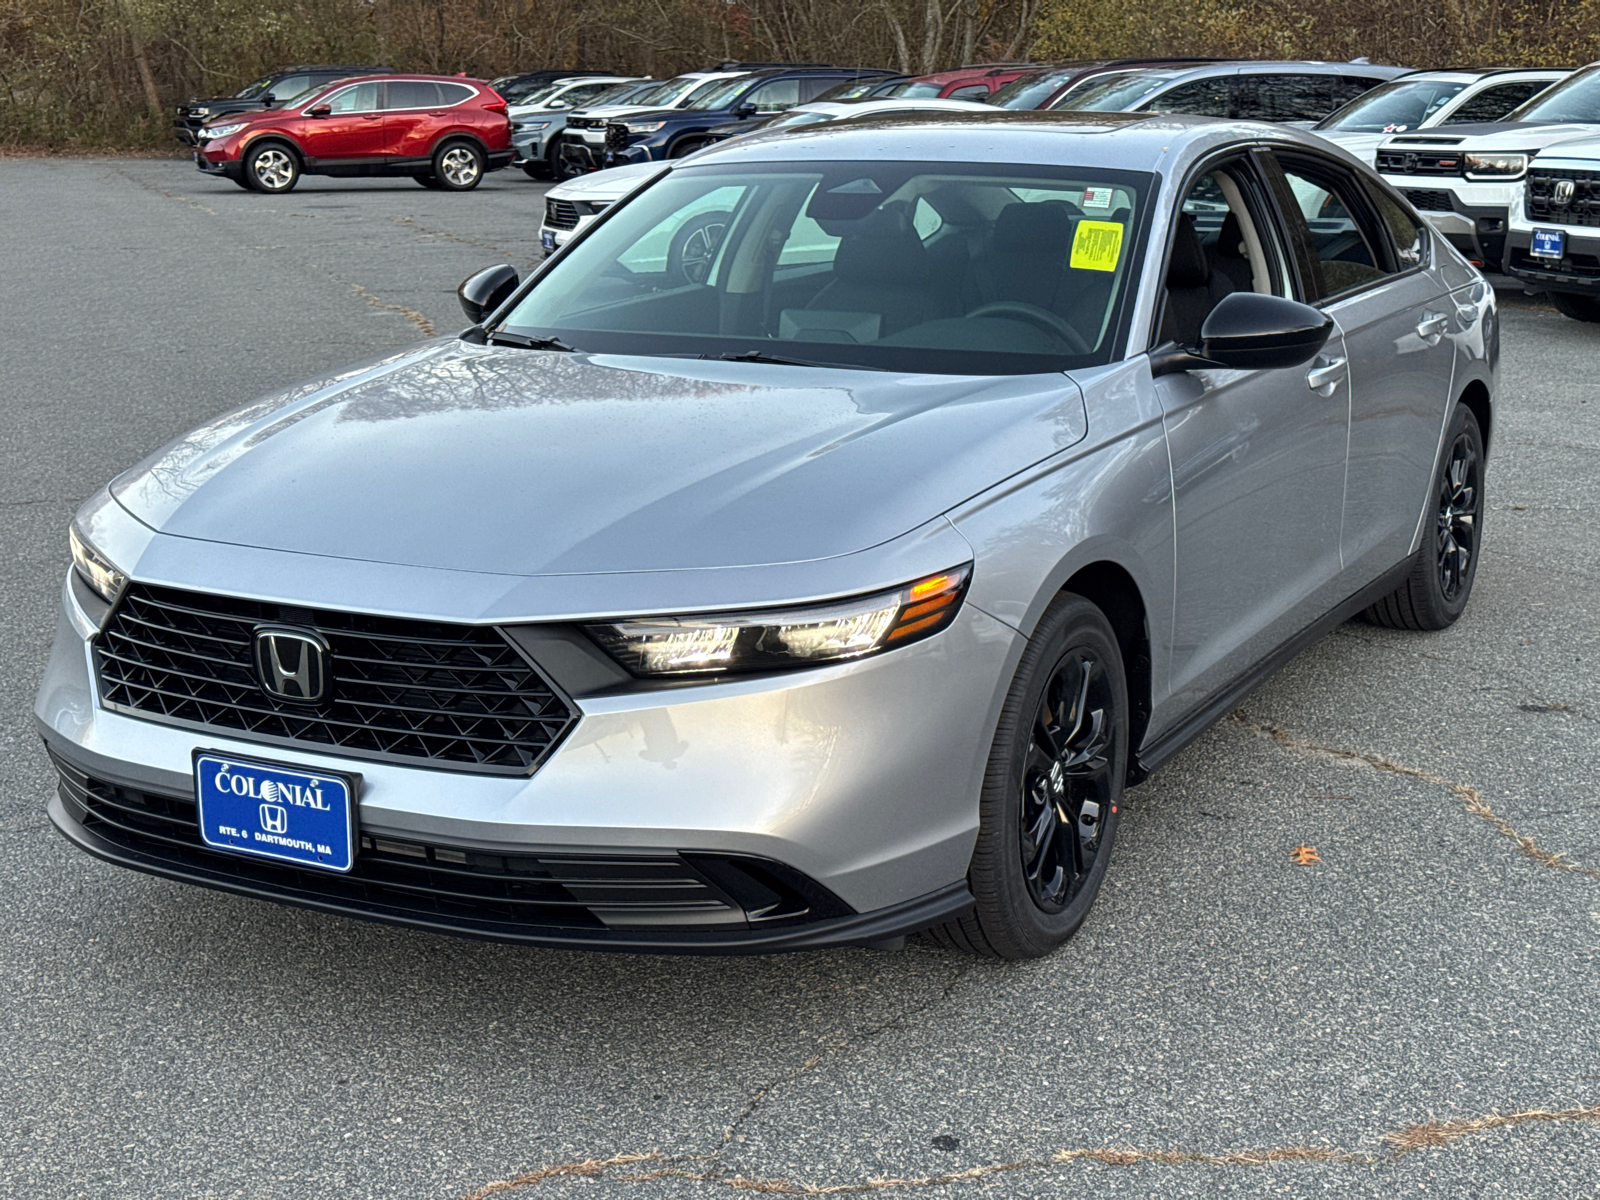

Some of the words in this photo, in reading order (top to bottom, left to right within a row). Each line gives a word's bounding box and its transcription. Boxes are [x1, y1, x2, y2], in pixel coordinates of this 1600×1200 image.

[214, 772, 331, 811] COLONIAL
[219, 825, 240, 837] RTE.
[241, 830, 248, 838] 6
[254, 832, 315, 853] DARTMOUTH,
[317, 844, 332, 855] MA
